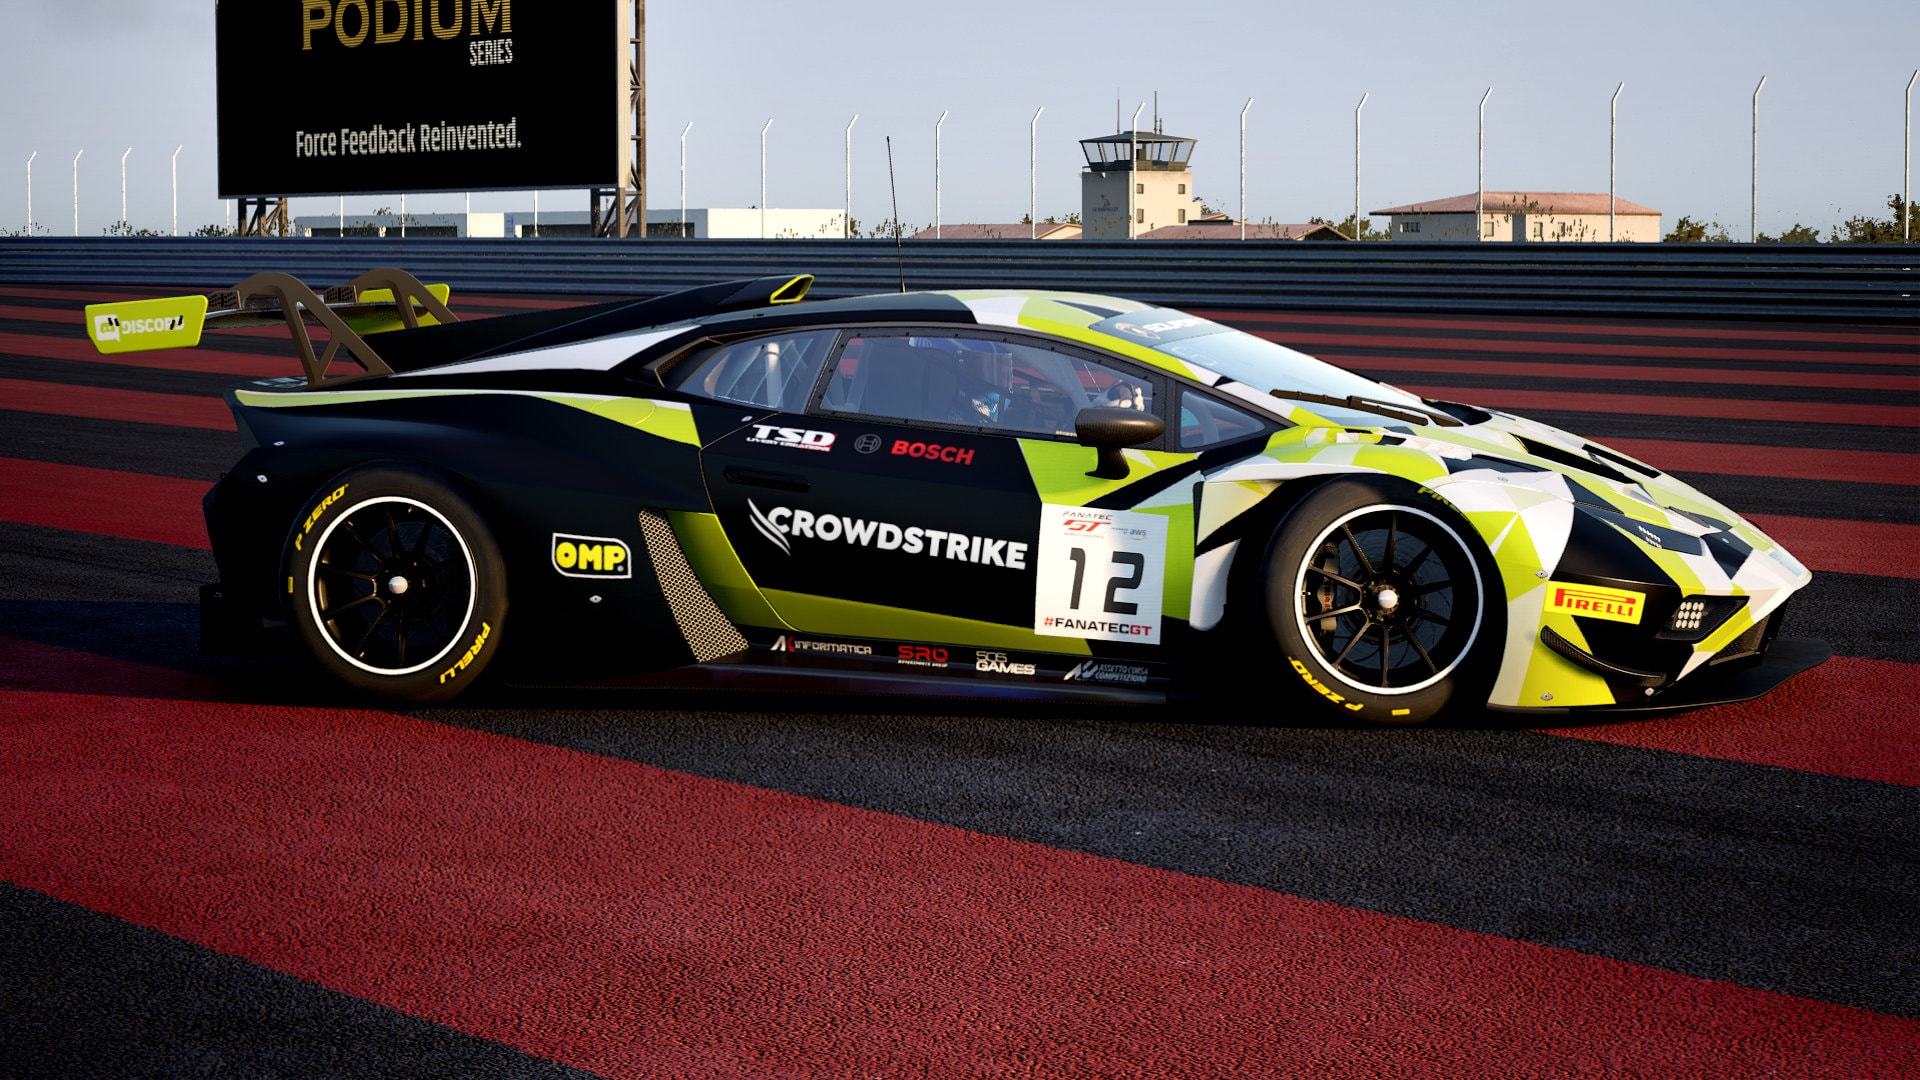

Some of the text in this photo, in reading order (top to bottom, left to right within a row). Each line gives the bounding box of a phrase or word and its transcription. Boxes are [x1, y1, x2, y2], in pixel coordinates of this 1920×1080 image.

[302, 0, 513, 50] PODIUM
[469, 39, 514, 66] SERIES
[296, 117, 522, 158] Force Feedback Reinvented.
[752, 424, 836, 447] TSD
[891, 440, 975, 465] BOSCH
[294, 485, 346, 551] P ZERO
[1062, 510, 1114, 521] FANATEC
[1062, 519, 1113, 532] GT
[767, 506, 1029, 570] CROWDSTRIKE
[556, 541, 626, 571] OMP
[1069, 547, 1145, 615] 12
[1554, 588, 1637, 617] PIRELLI
[1043, 617, 1153, 636] #FANATECGT
[440, 622, 491, 684] PIRELLI
[794, 640, 872, 655] INFORMATICA
[898, 645, 949, 662] SRO
[975, 660, 1036, 676] GAMES
[1289, 659, 1364, 711] P ZERO
